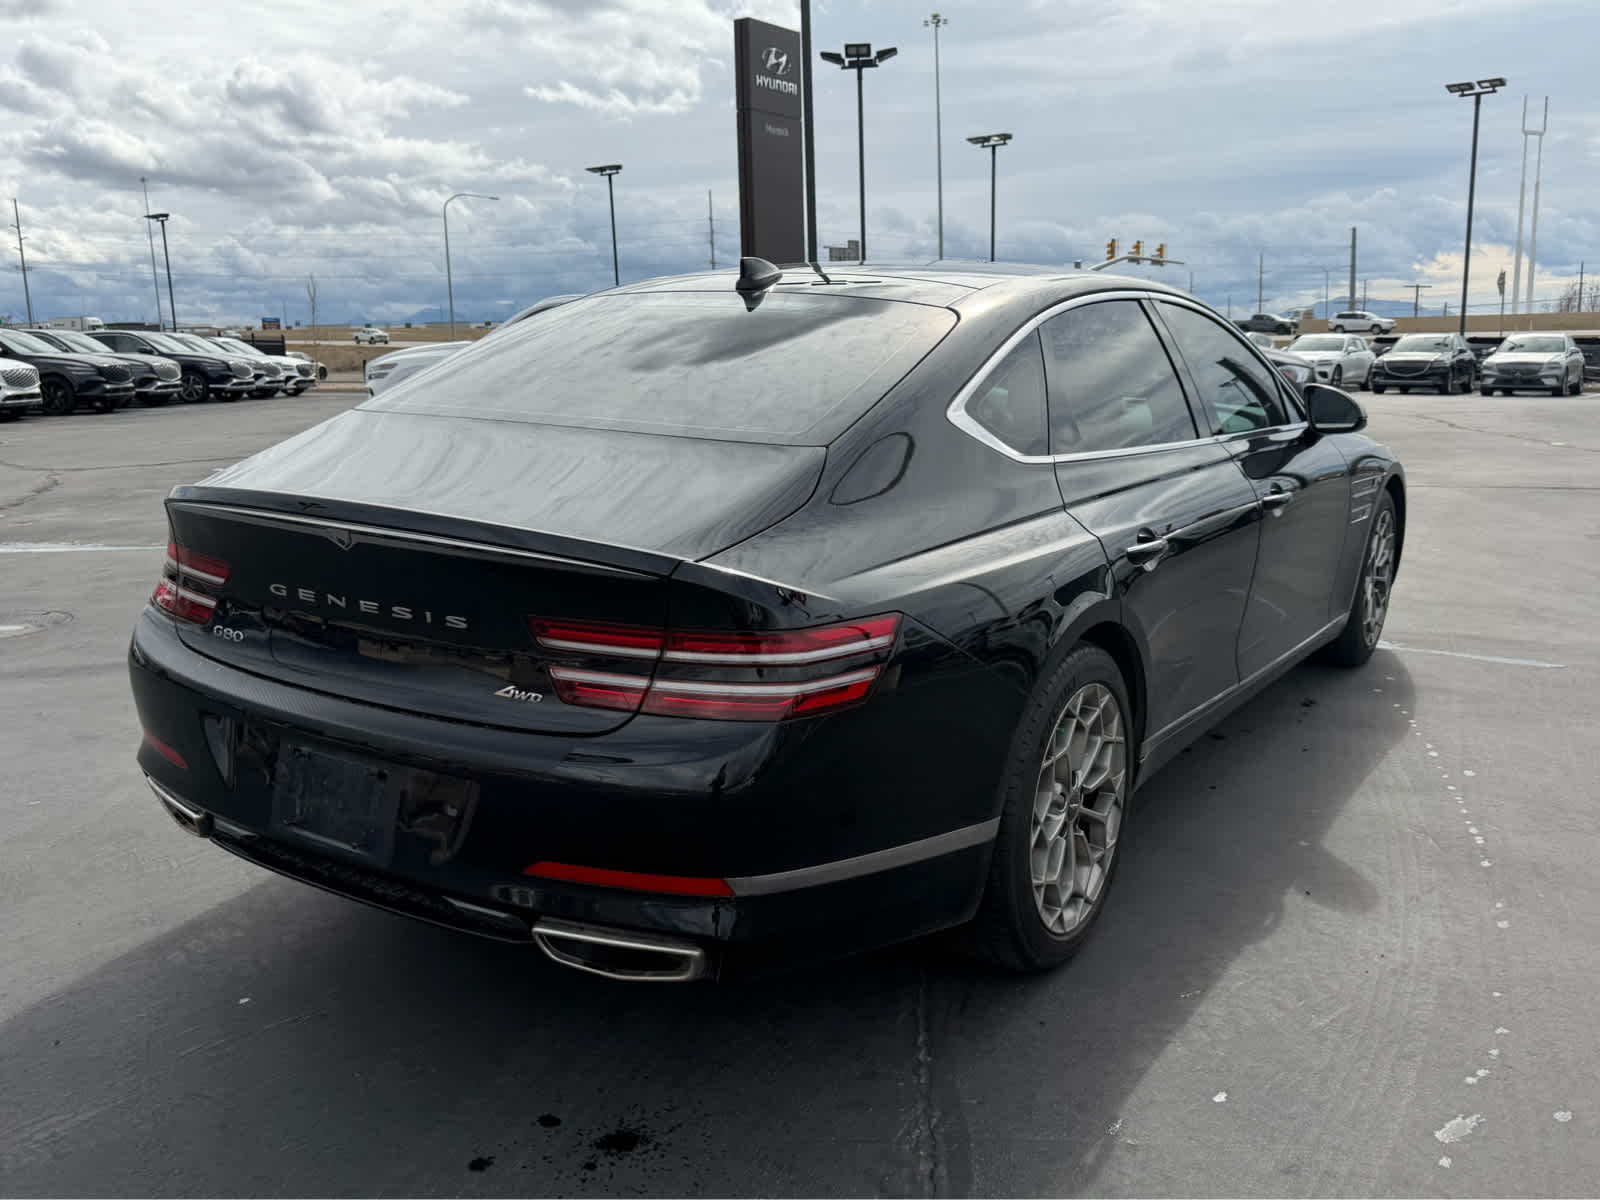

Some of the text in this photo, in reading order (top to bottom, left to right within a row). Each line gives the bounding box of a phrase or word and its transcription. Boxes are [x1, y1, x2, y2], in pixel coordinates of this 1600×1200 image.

[756, 74, 798, 95] HYUNDAI
[269, 583, 468, 629] GENESIS
[213, 625, 244, 642] G80
